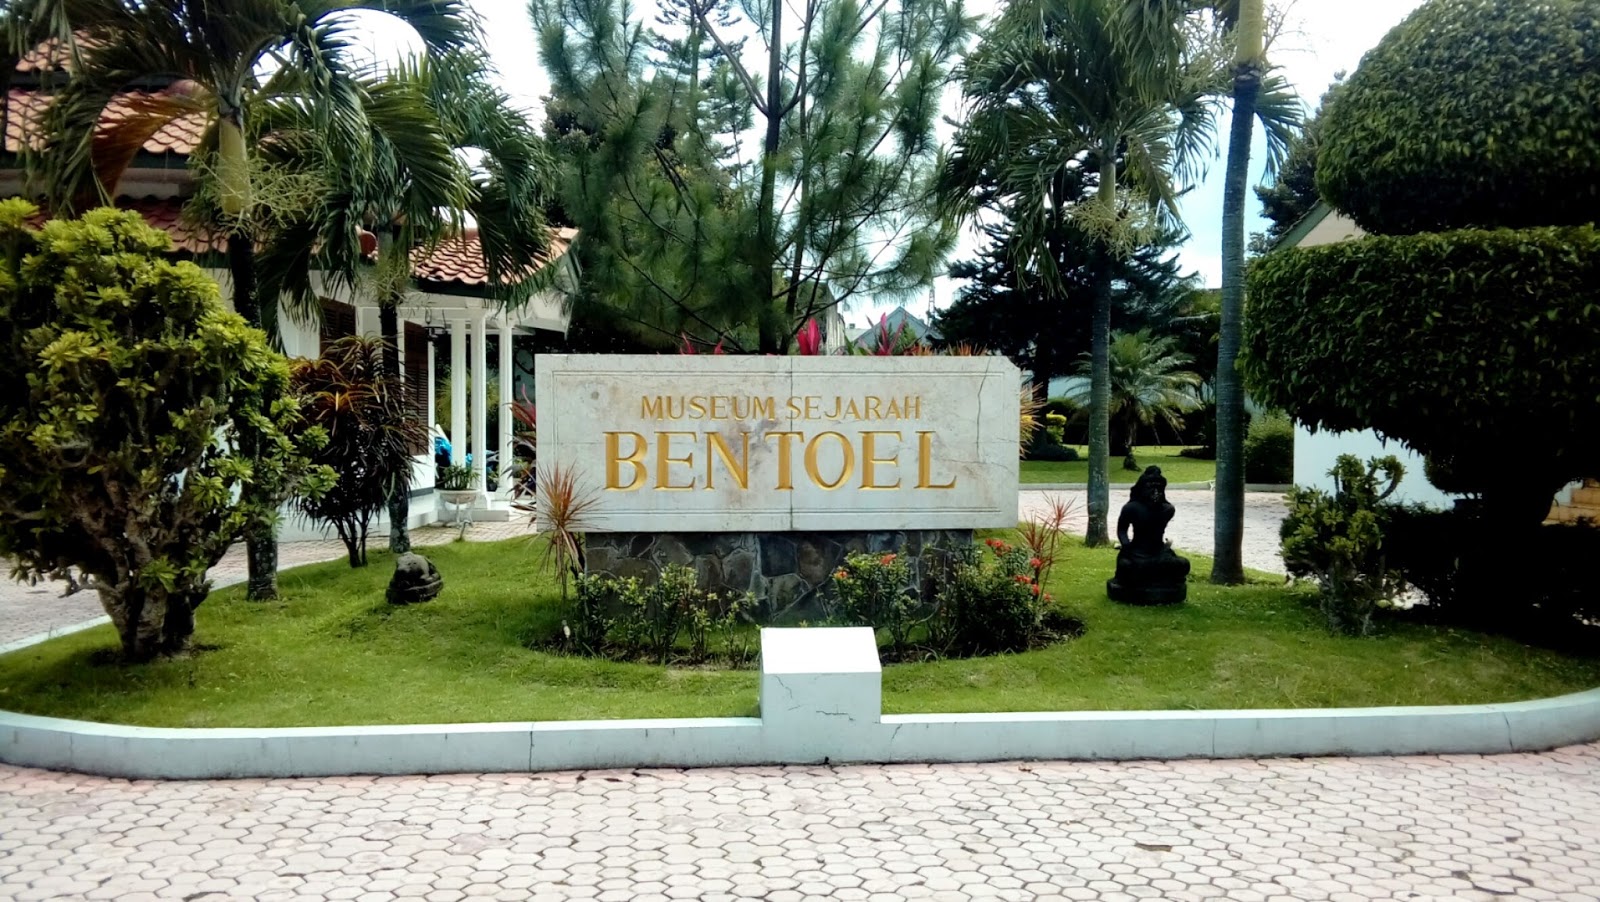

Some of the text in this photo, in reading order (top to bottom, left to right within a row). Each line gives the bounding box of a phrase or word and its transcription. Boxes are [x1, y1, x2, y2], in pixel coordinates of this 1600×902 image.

[641, 396, 921, 420] MUSEUM SEJARAH
[603, 430, 957, 491] BENTOEL
